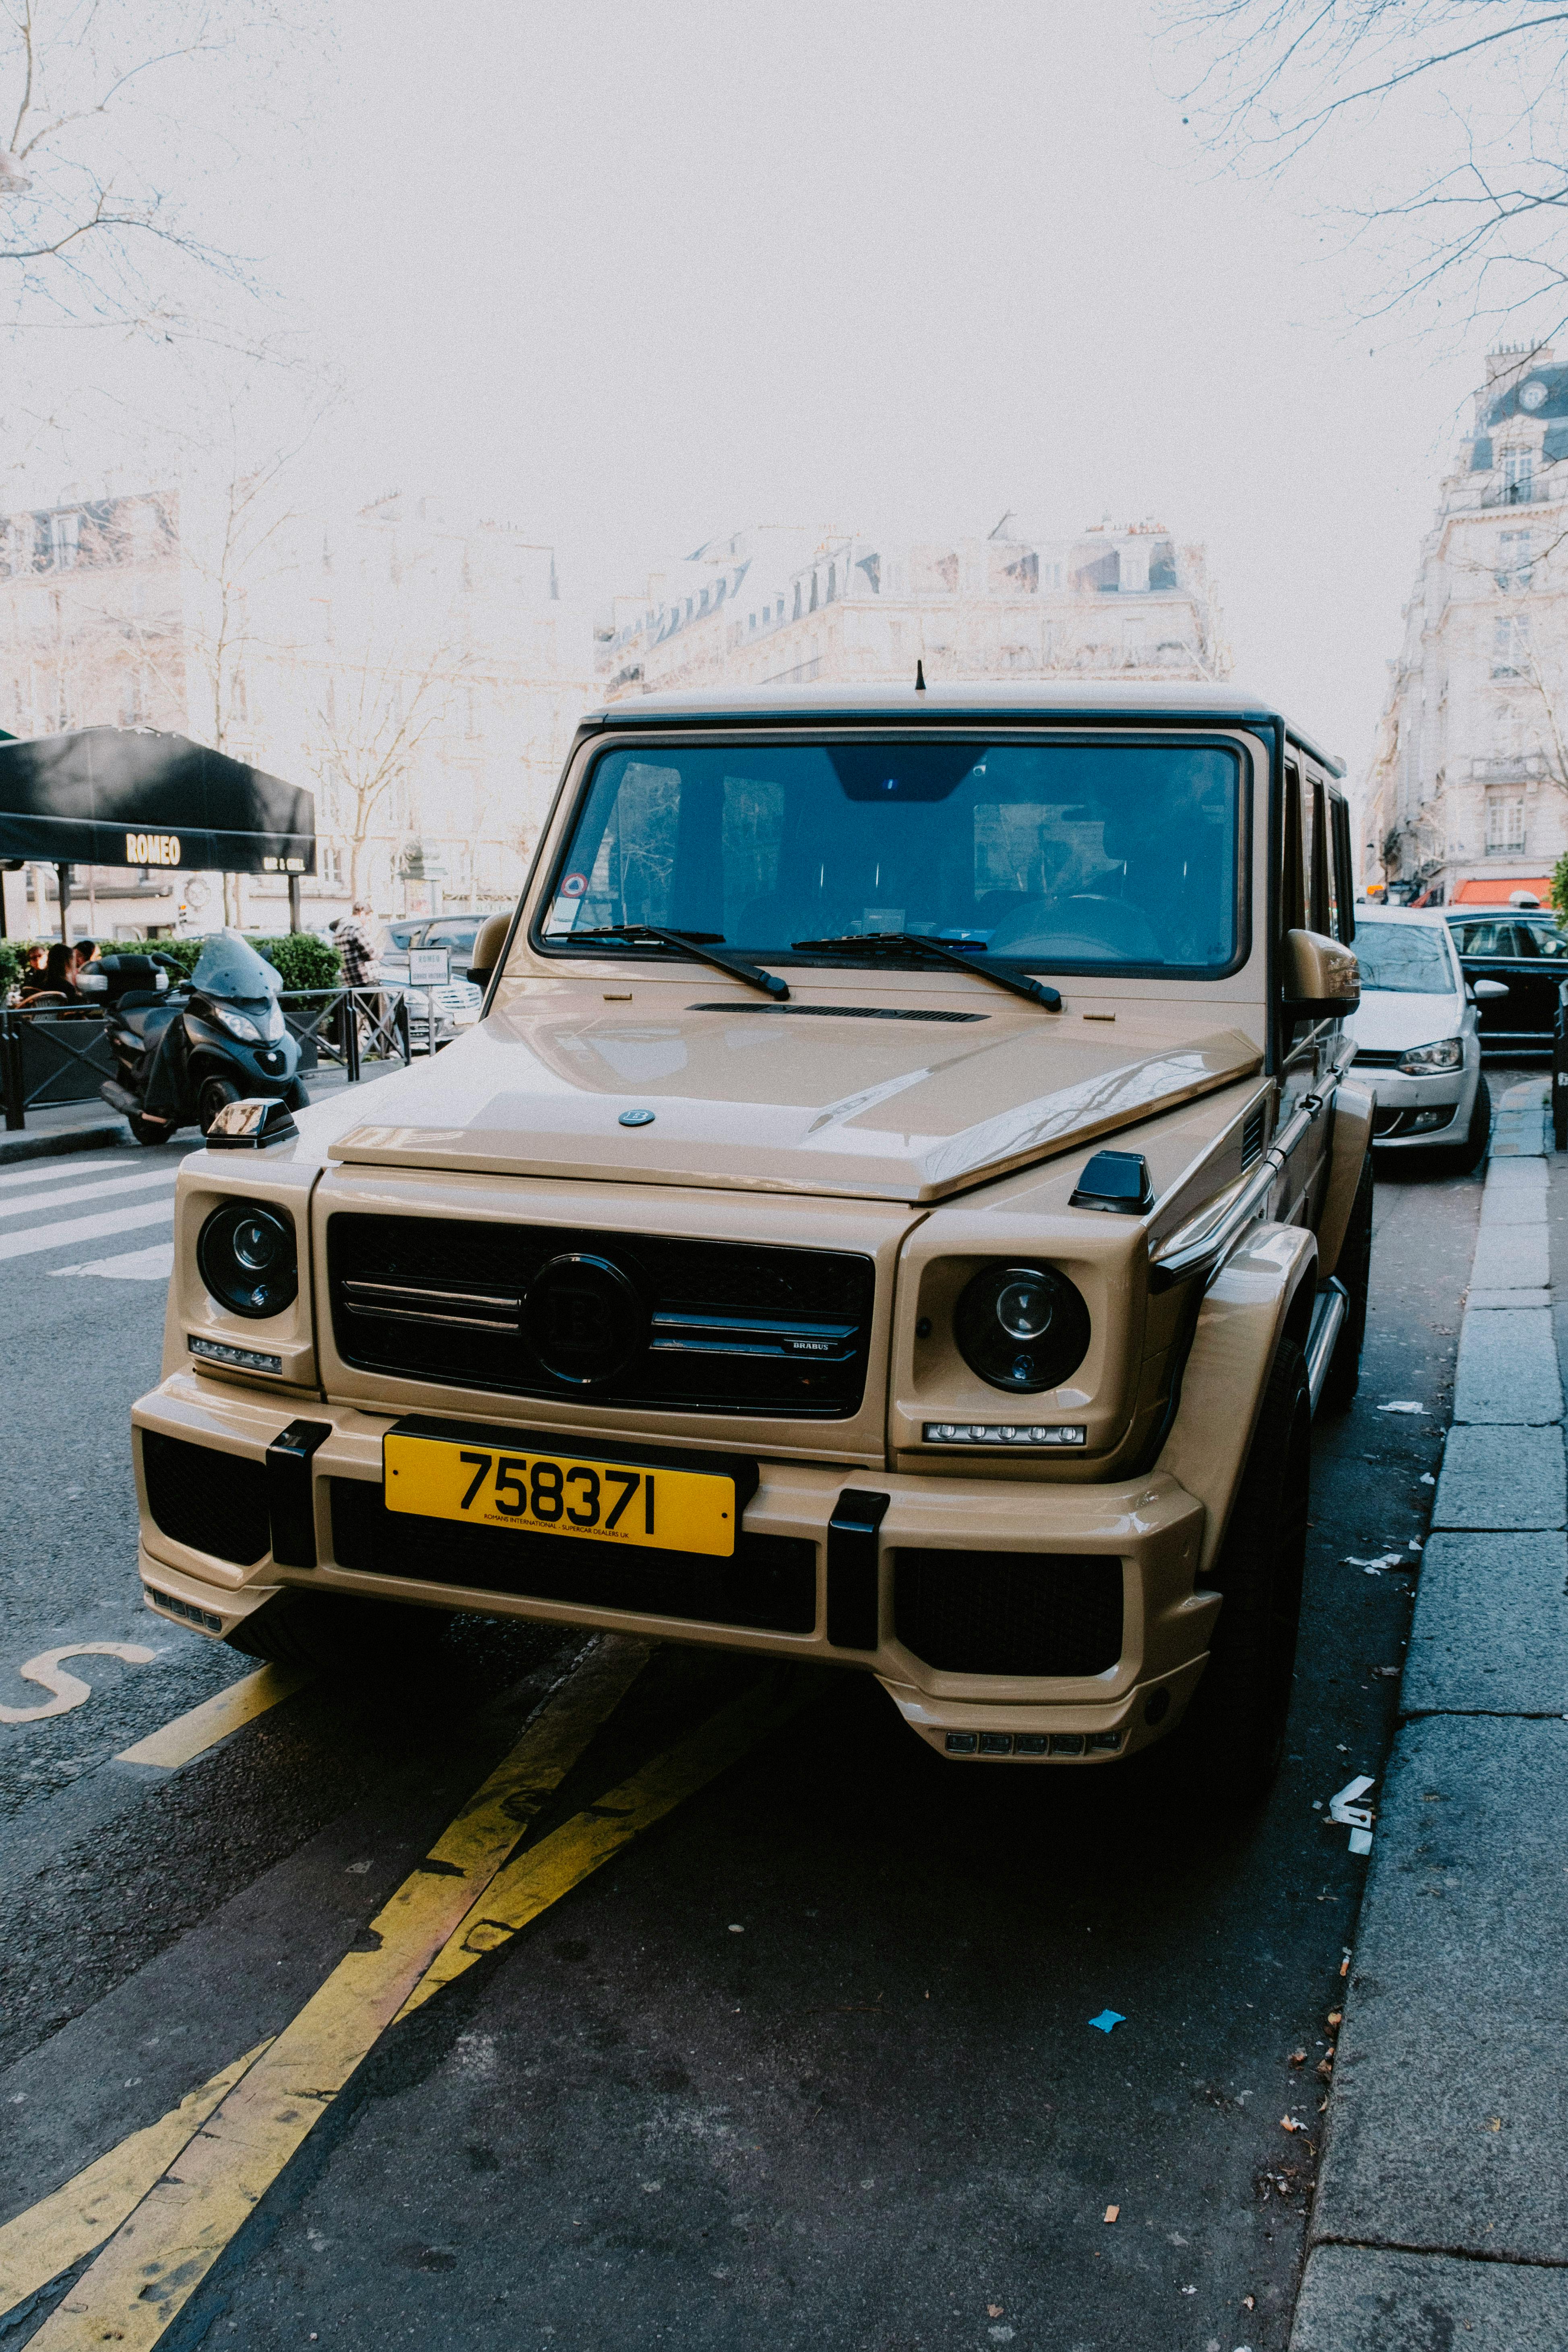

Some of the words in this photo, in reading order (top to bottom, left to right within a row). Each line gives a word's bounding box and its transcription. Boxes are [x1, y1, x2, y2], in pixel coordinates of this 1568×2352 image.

[126, 833, 180, 865] ROMEO
[623, 1111, 649, 1121] B
[460, 1451, 655, 1535] 758371
[484, 1514, 509, 1522] ROMANS
[510, 1517, 557, 1529] INTERNATIONAL
[562, 1525, 592, 1533] SUPERCAR
[593, 1529, 619, 1537] DEALERS
